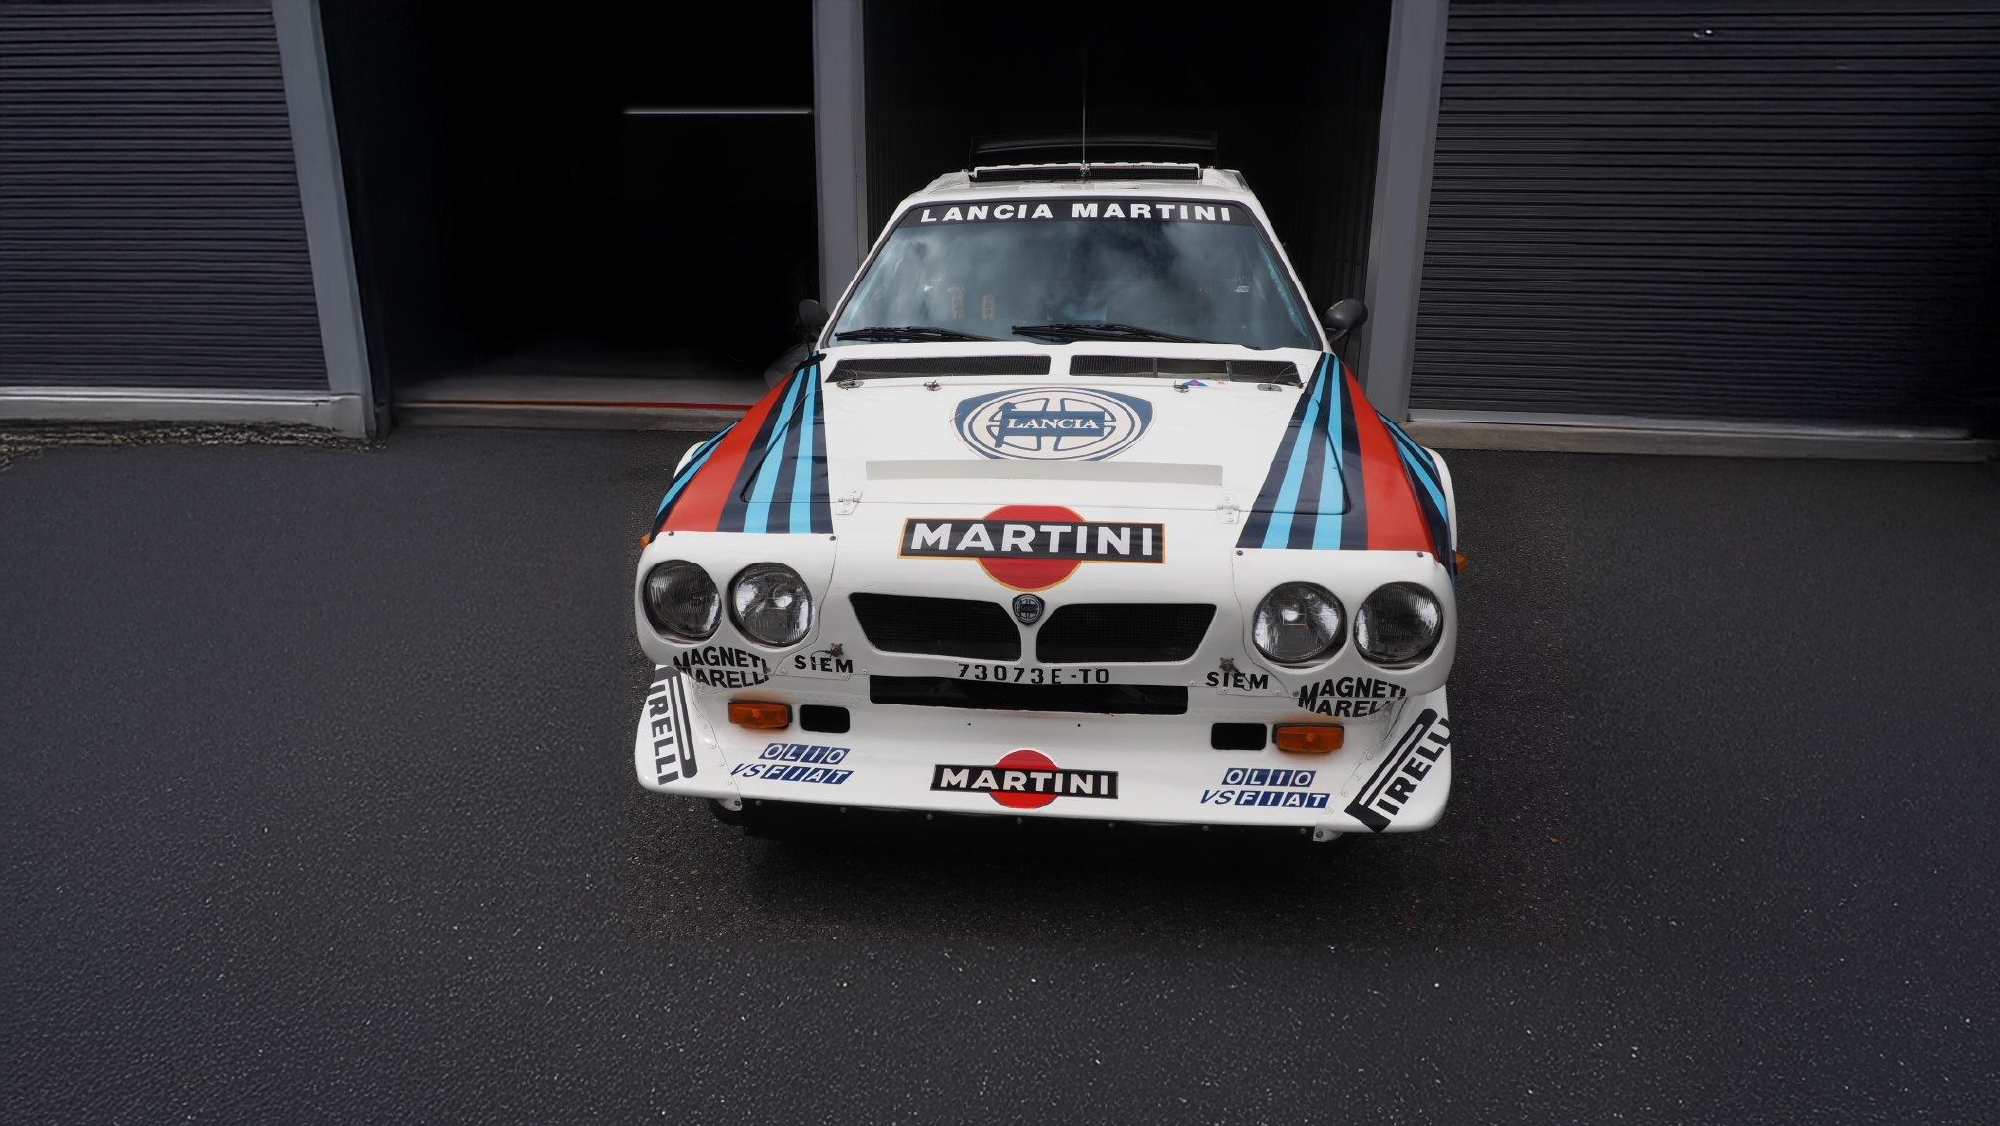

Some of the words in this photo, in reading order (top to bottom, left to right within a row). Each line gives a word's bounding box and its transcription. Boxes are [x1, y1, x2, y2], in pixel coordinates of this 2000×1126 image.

[920, 203, 1054, 223] LANCIA
[1071, 203, 1231, 222] MARTINI
[1006, 418, 1100, 430] LANCIA
[910, 523, 1153, 556] MARTINI
[672, 645, 769, 674] MAGNETI
[794, 655, 853, 674] SIEM
[1205, 671, 1269, 690] SIEM
[1299, 676, 1407, 698] MAGNETI
[648, 665, 698, 786] PIRELLI
[761, 743, 848, 765] OLIO
[940, 768, 1109, 796] MARTINI
[1224, 768, 1314, 787] OLIO
